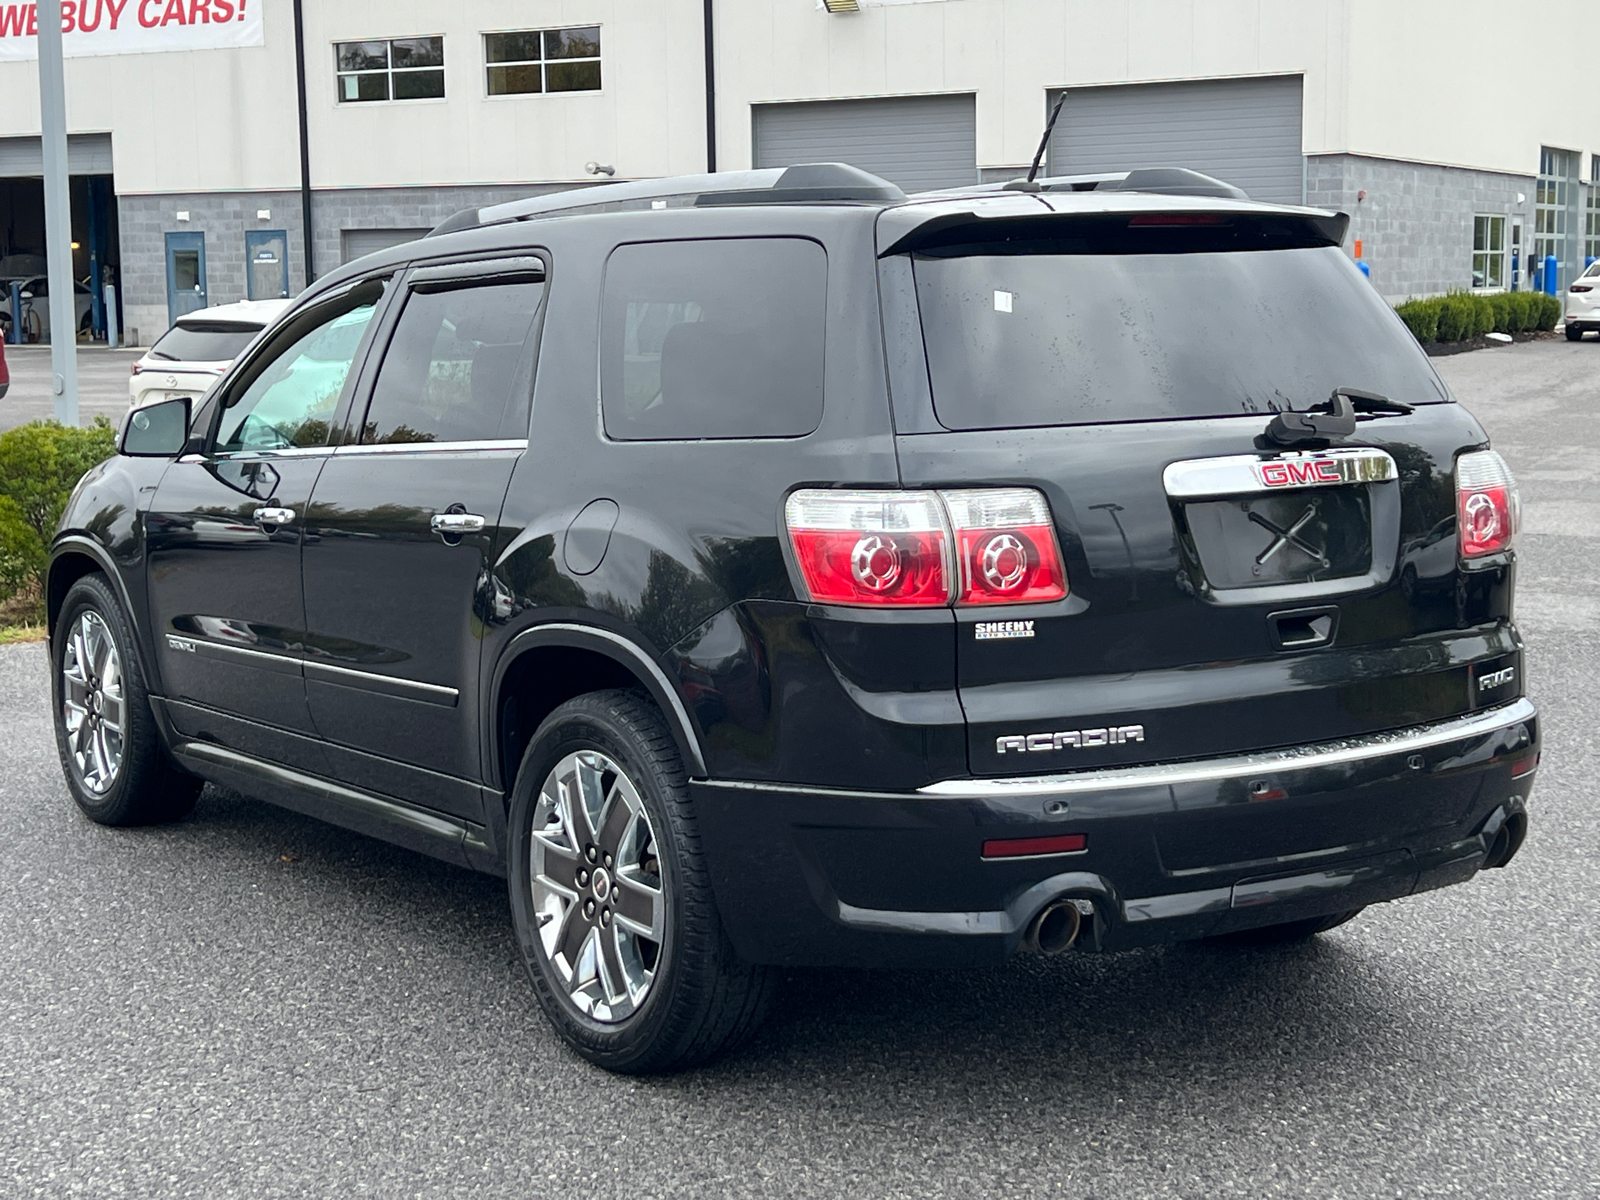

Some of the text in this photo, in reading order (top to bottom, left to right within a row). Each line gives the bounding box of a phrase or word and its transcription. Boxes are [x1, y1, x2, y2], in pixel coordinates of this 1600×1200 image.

[0, 0, 246, 37] WE BUY CARS!
[1261, 460, 1341, 487] GMC
[975, 620, 1034, 633] SHEEHY
[168, 639, 196, 653] DENALI
[1479, 666, 1514, 691] AWD
[996, 724, 1145, 753] ACADIA
